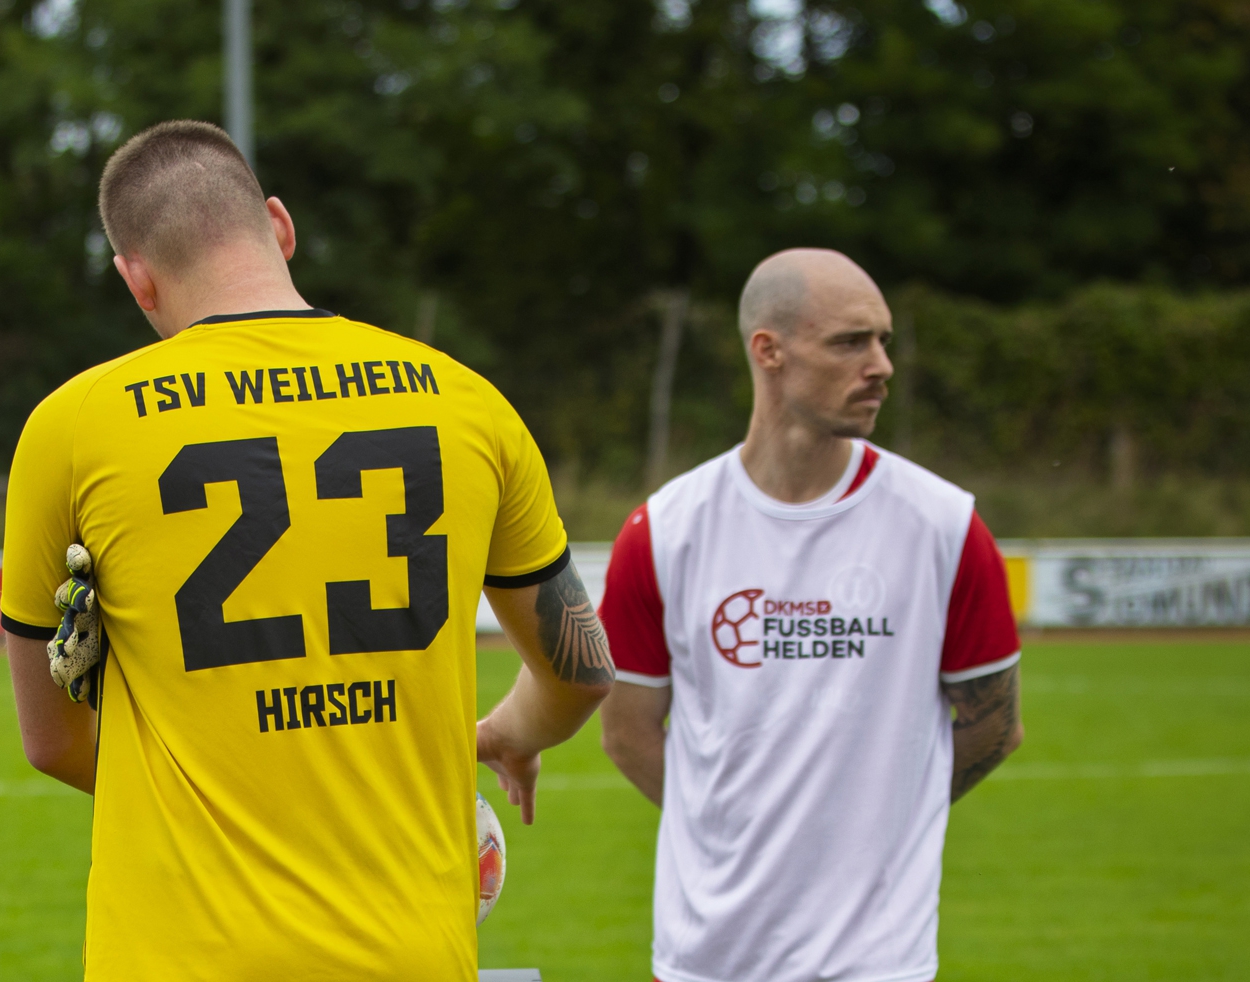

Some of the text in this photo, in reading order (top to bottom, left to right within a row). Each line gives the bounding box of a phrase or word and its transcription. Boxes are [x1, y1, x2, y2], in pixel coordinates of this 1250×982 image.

[125, 360, 440, 418] TSV WEILHEIM
[158, 426, 449, 672] 23
[763, 600, 817, 616] DKMS
[763, 617, 894, 638] FUSSBALL
[763, 639, 865, 660] HELDEN
[255, 680, 397, 733] HIRSCH
